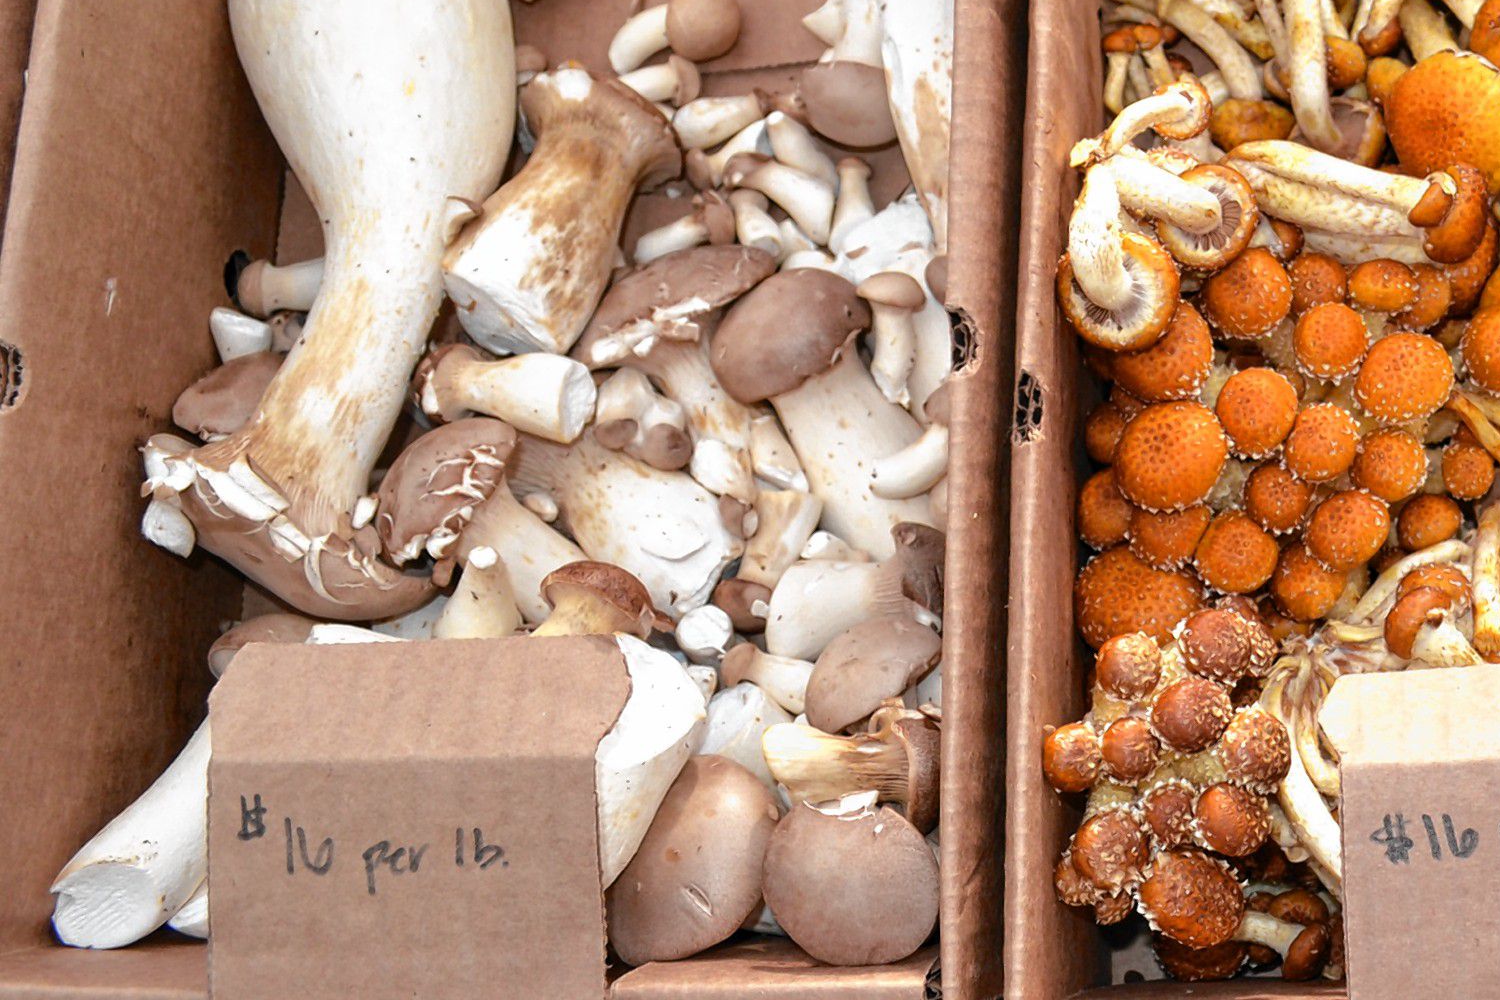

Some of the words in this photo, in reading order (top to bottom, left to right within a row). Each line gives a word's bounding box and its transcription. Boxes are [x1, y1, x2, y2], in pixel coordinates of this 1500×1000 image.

[362, 840, 429, 895] per
[455, 827, 510, 870] lb.
[1369, 812, 1479, 865] $16
